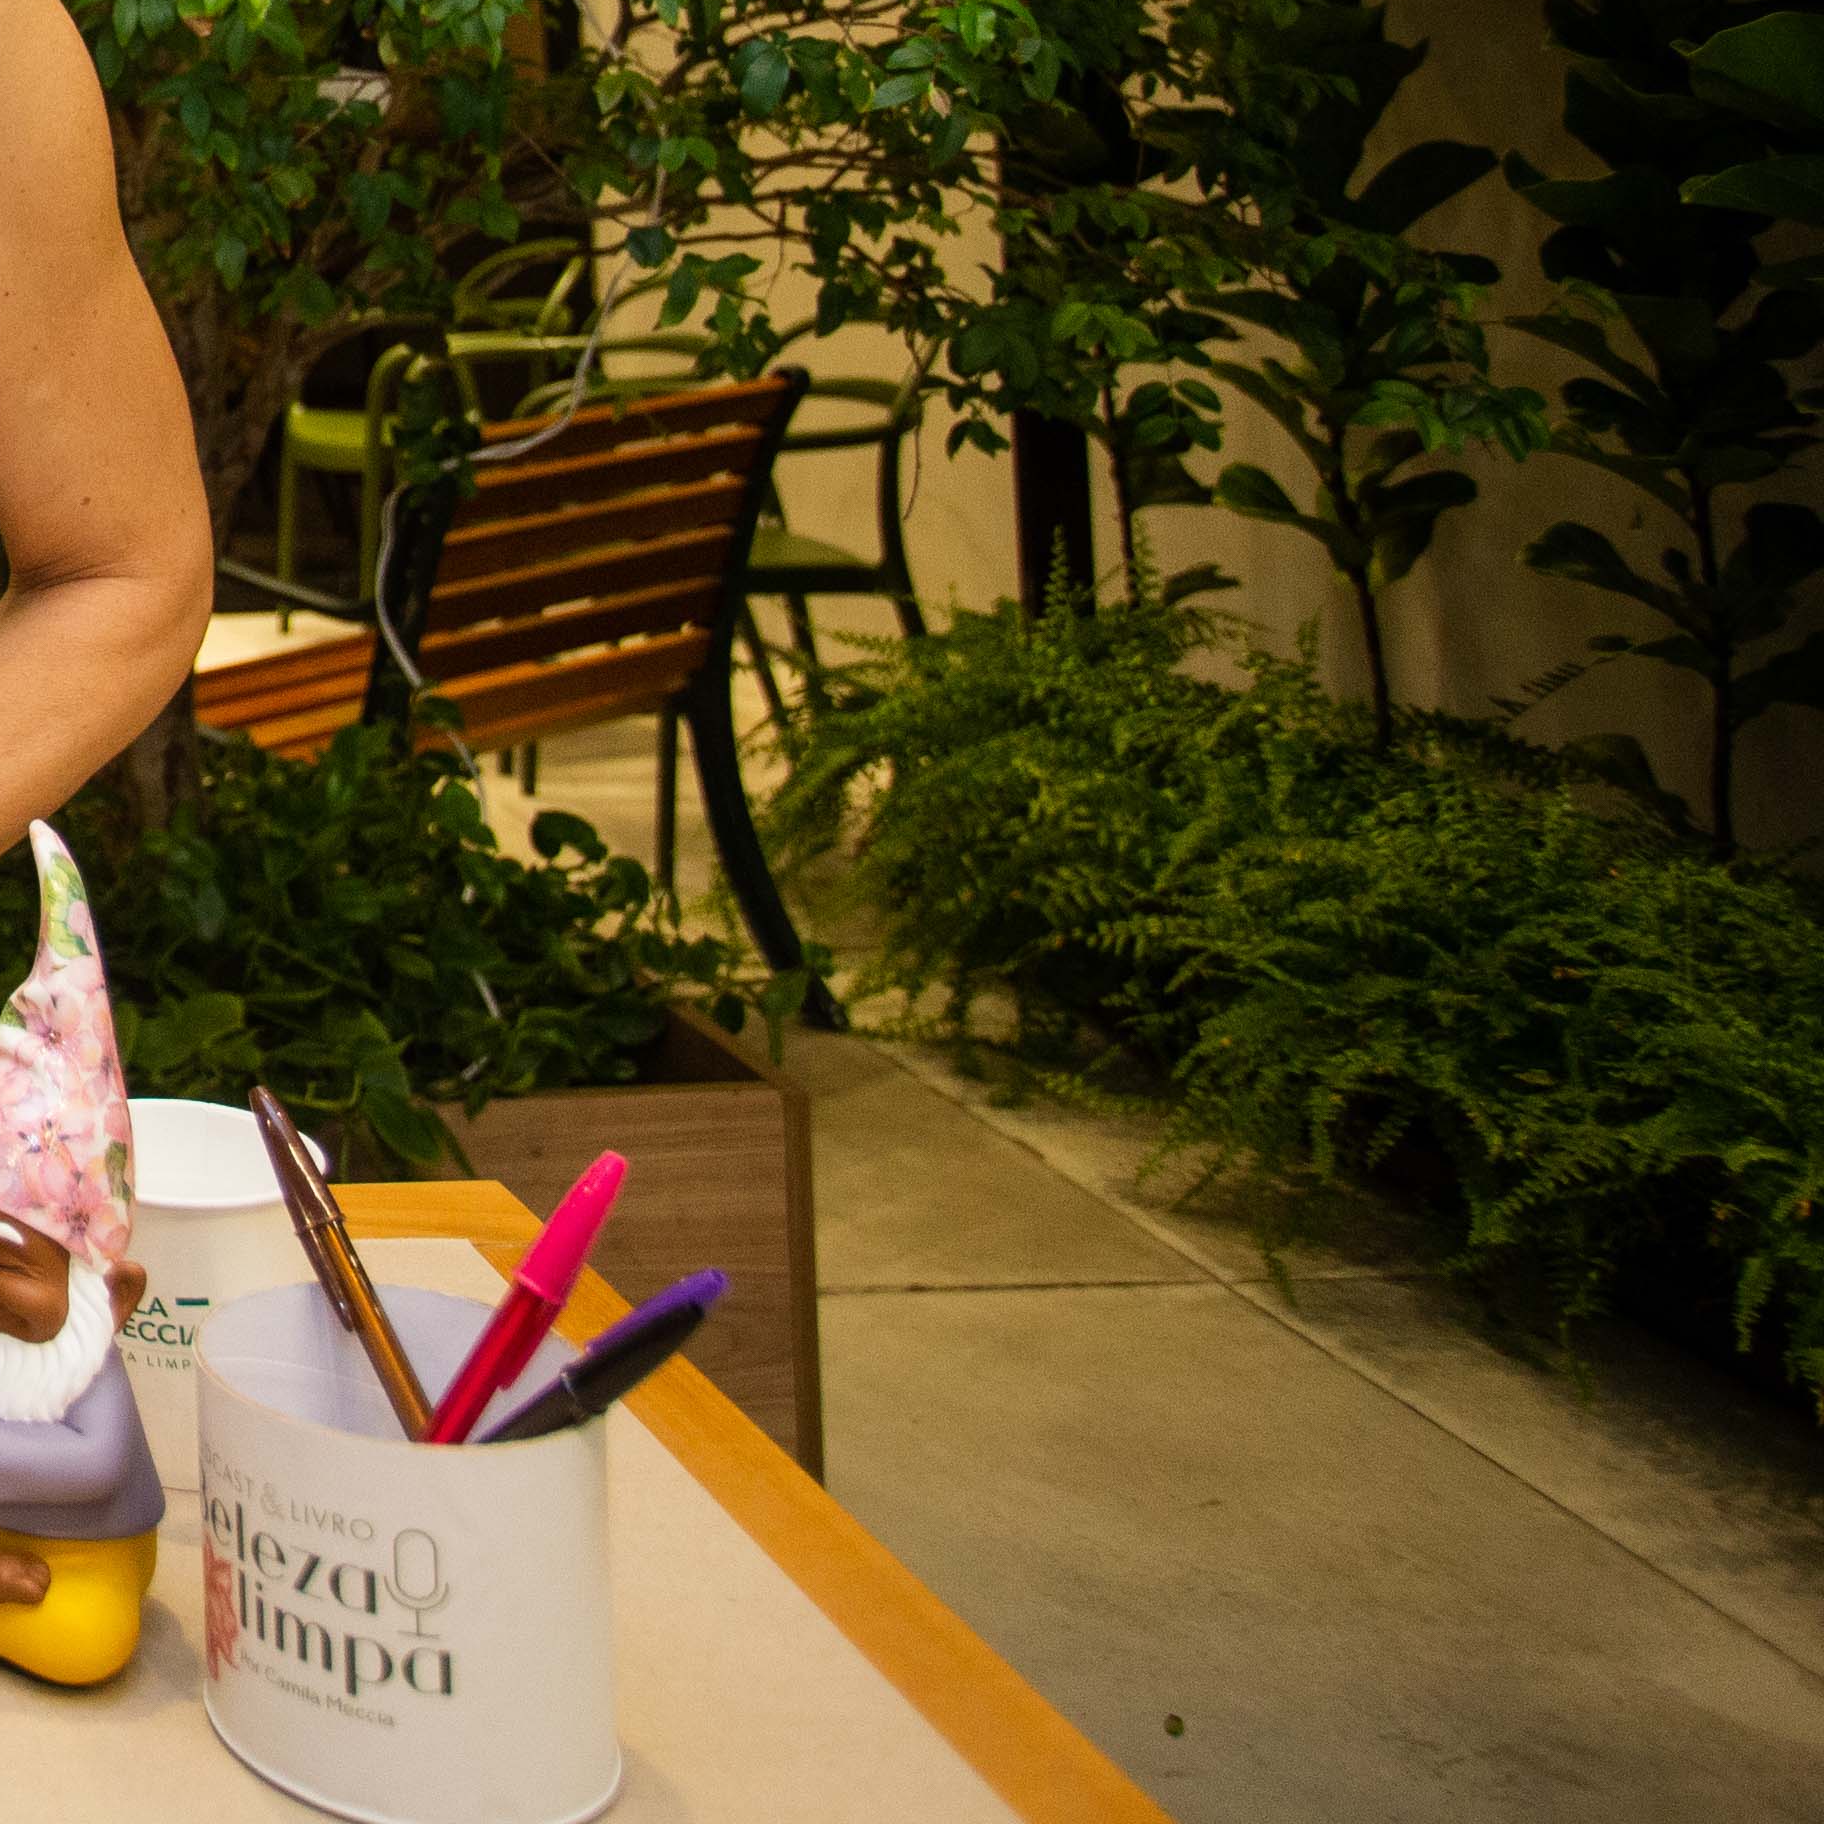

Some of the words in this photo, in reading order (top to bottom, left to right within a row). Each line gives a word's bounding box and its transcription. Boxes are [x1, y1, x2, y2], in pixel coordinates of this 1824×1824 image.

[146, 1354, 192, 1370] LIMP
[201, 1469, 378, 1616] eleza
[290, 1497, 375, 1541] LIVRO
[238, 1568, 453, 1697] limpa
